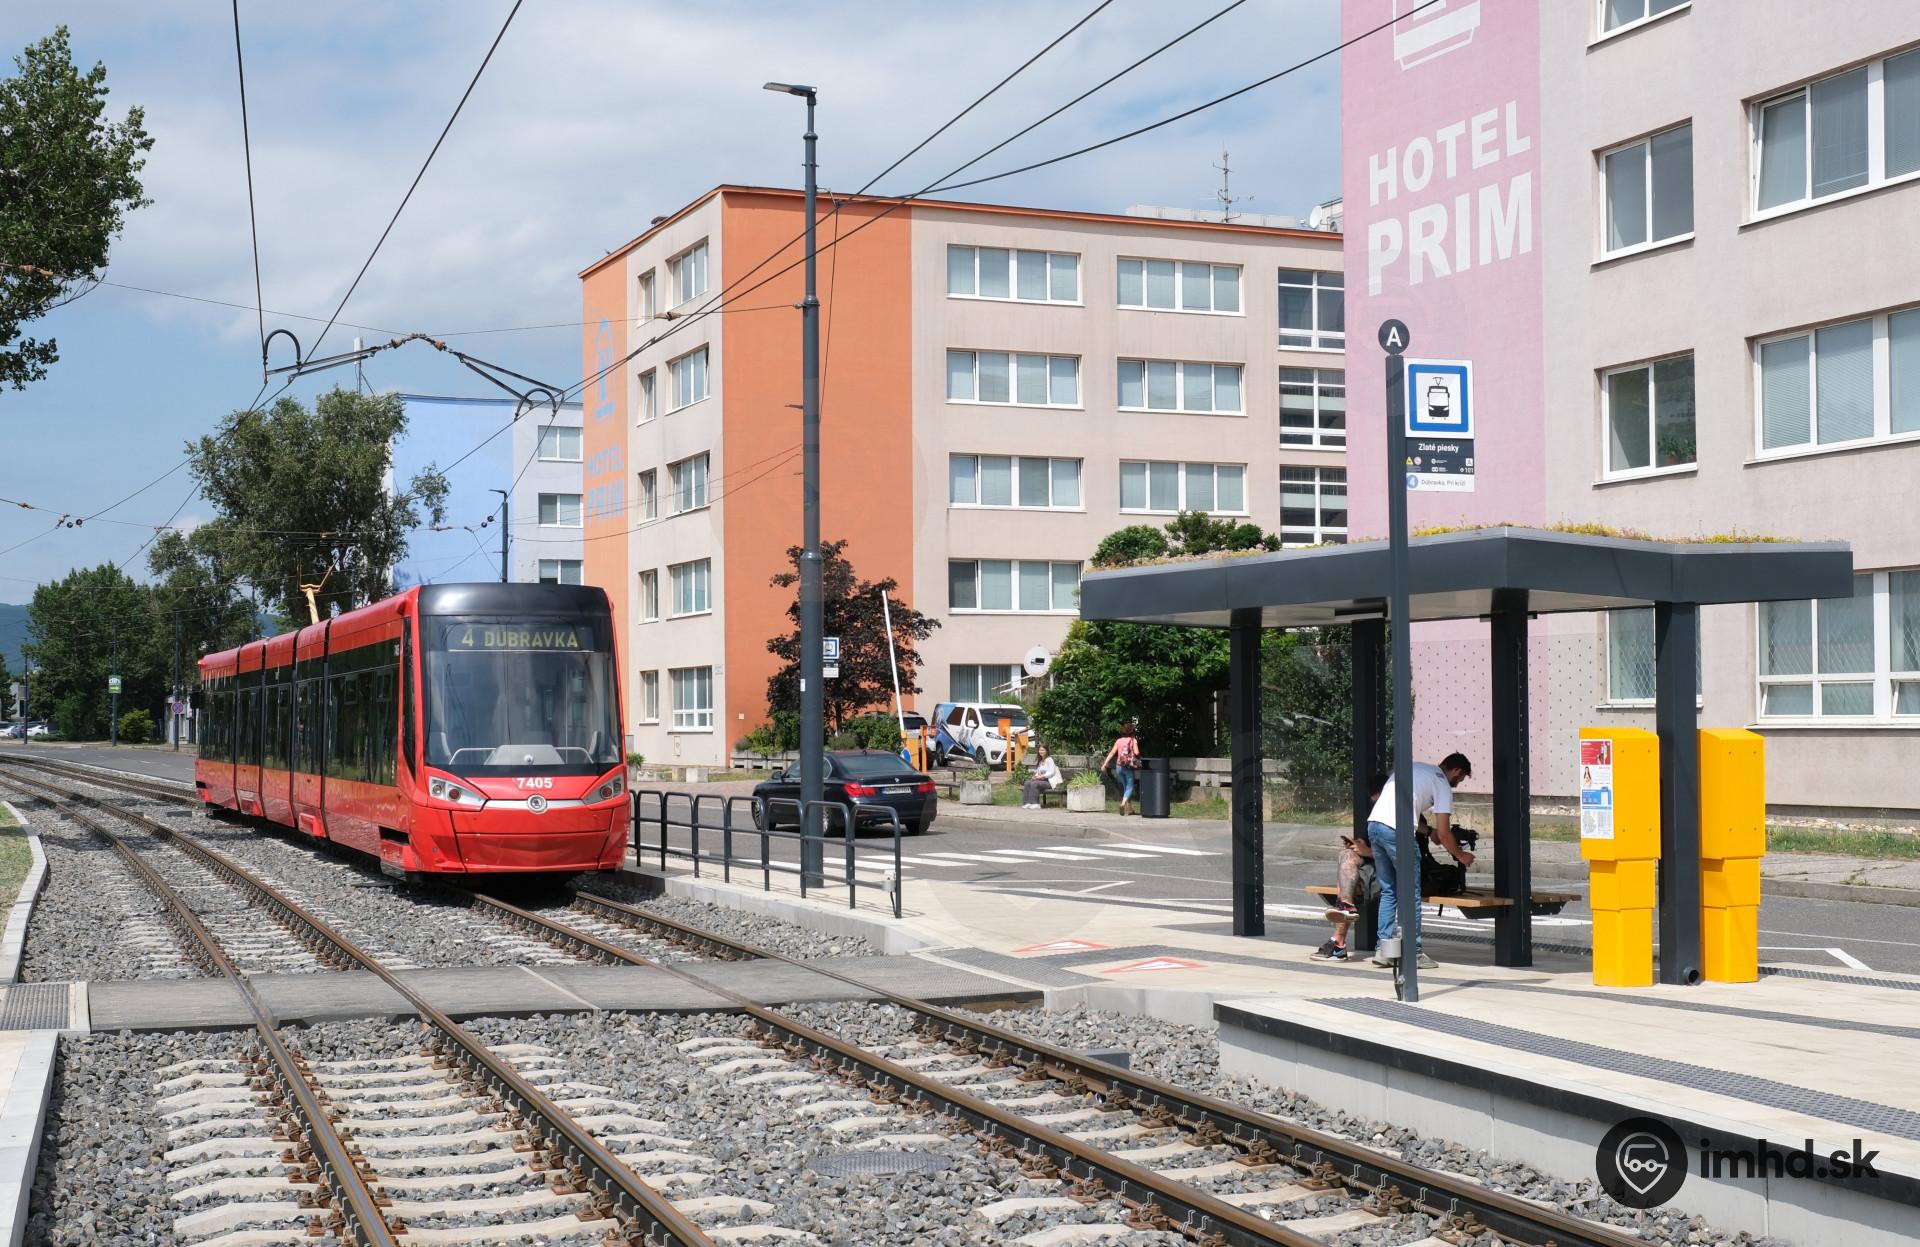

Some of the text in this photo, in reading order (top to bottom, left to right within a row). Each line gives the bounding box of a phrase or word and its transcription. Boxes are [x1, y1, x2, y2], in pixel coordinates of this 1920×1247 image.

[1368, 100, 1532, 207] HOTEL
[1367, 171, 1533, 297] PRIM
[1386, 326, 1402, 347] A
[1418, 443, 1459, 454] Zlaté piesky
[461, 628, 474, 647] 4
[516, 777, 553, 789] 7405
